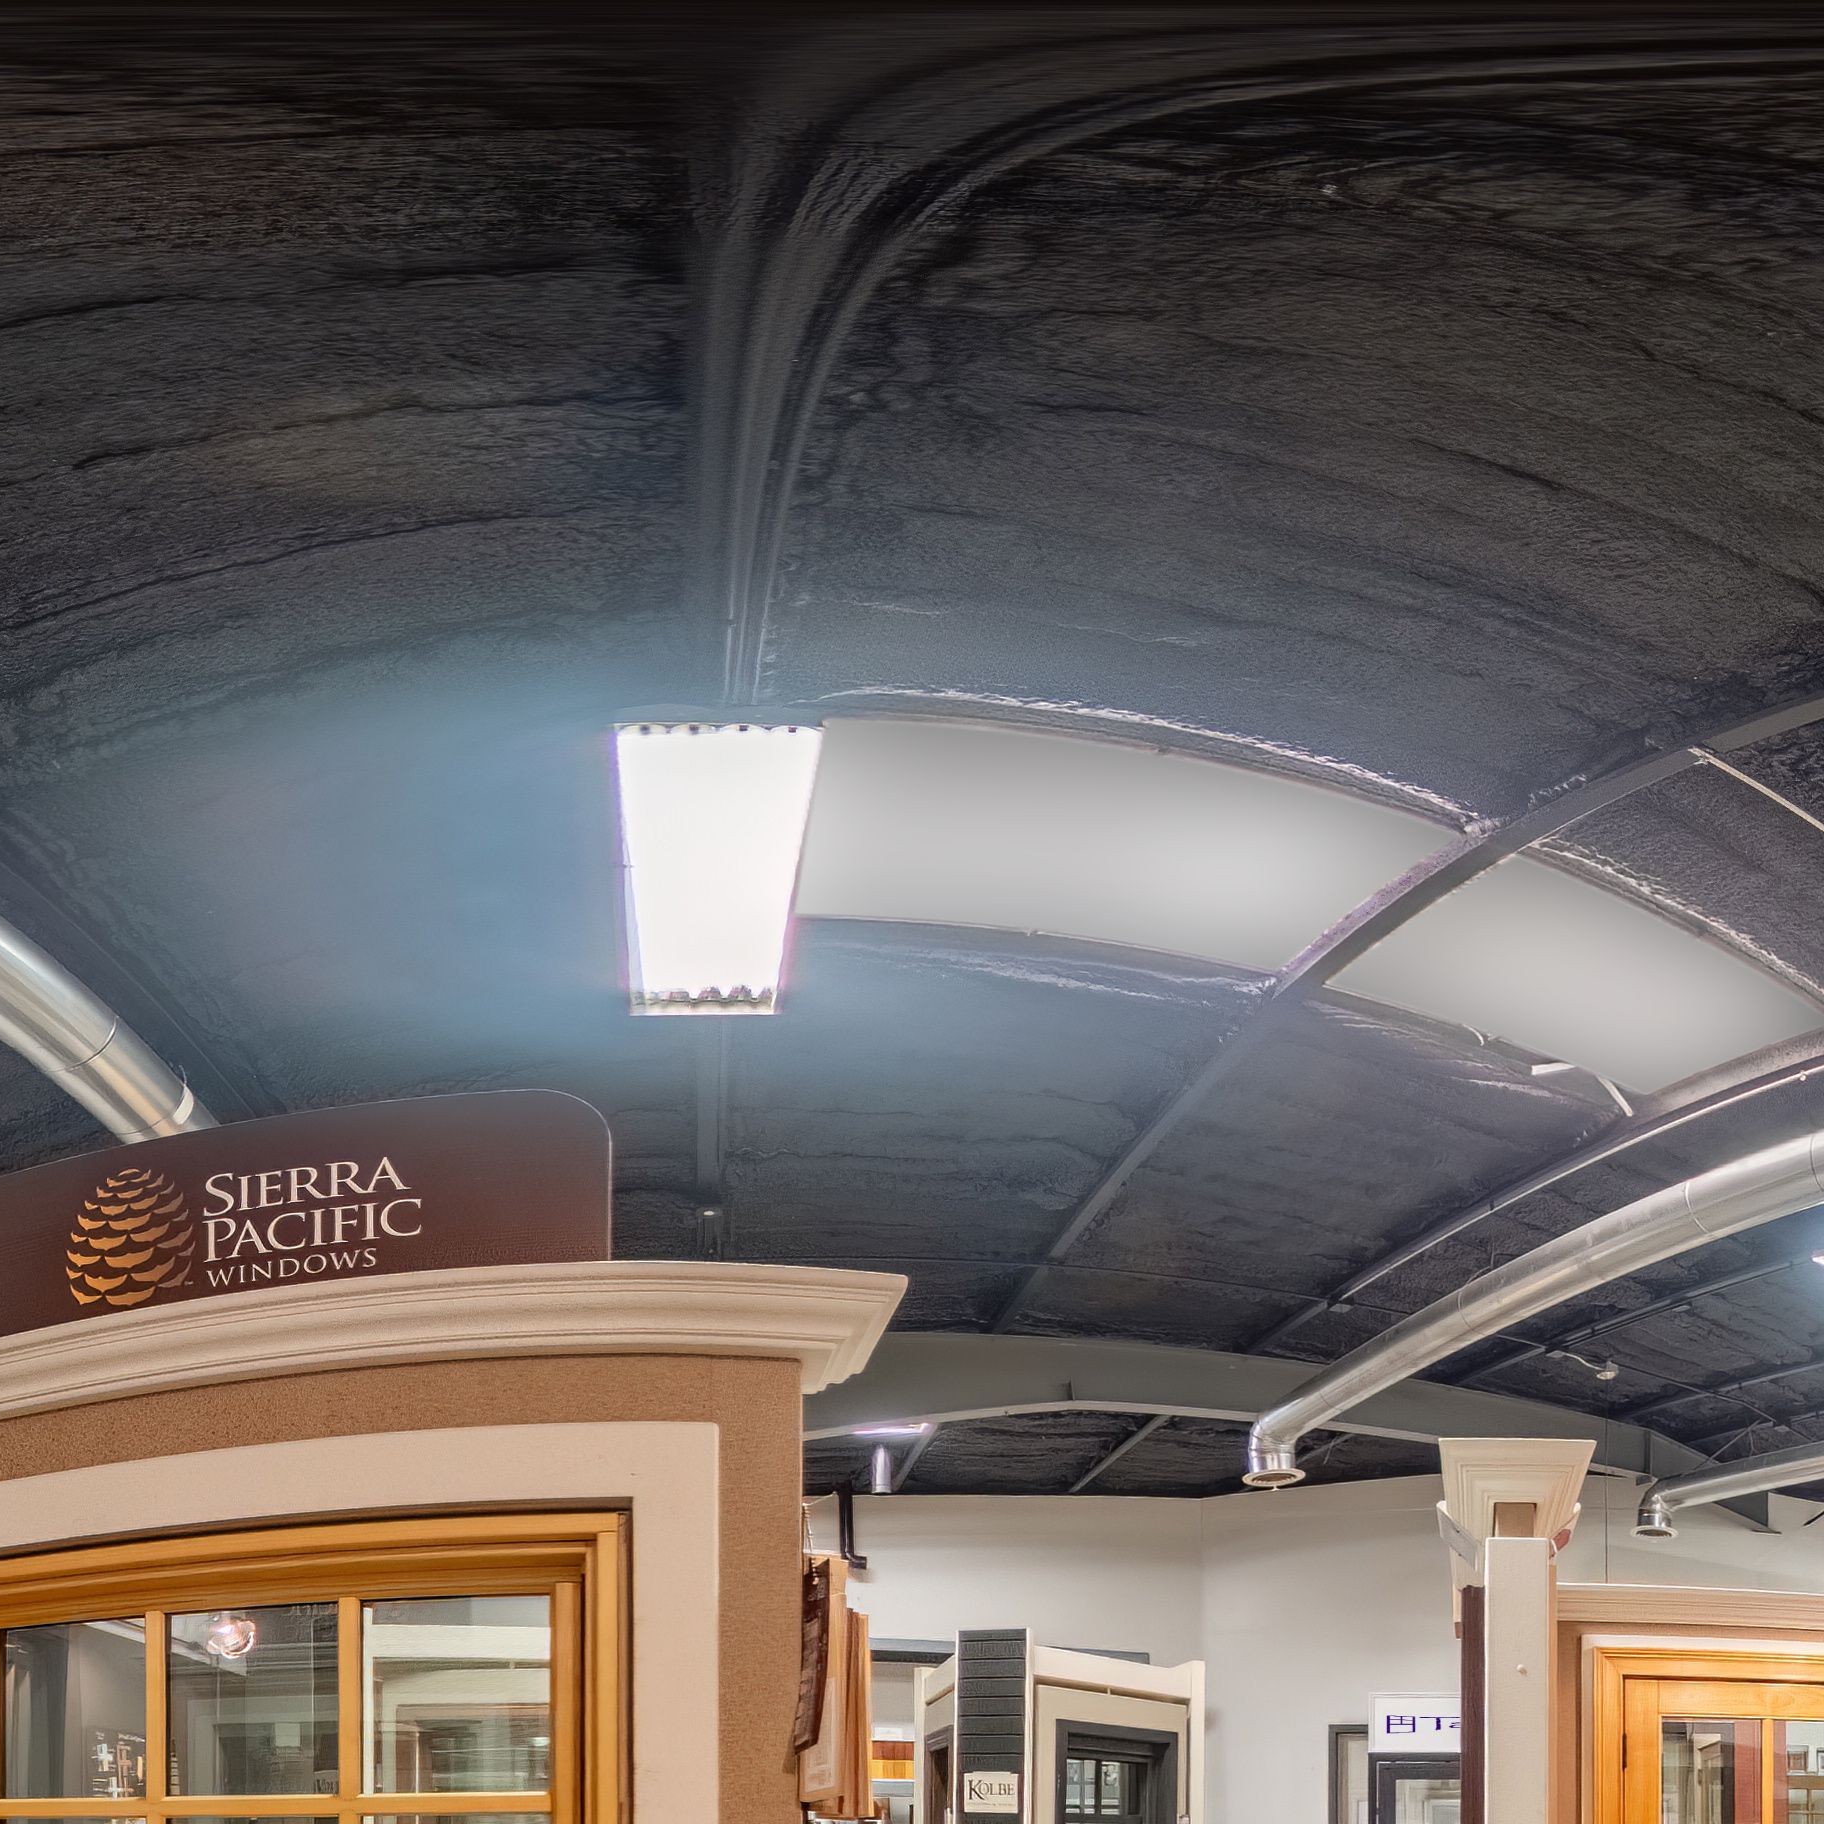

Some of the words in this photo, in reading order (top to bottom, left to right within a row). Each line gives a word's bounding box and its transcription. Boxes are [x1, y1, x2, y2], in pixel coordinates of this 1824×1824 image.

[203, 1156, 412, 1217] SIERRA
[203, 1198, 422, 1264] PACIFIC
[206, 1248, 378, 1287] WINDOWS
[967, 1779, 1016, 1800] KOLBE
